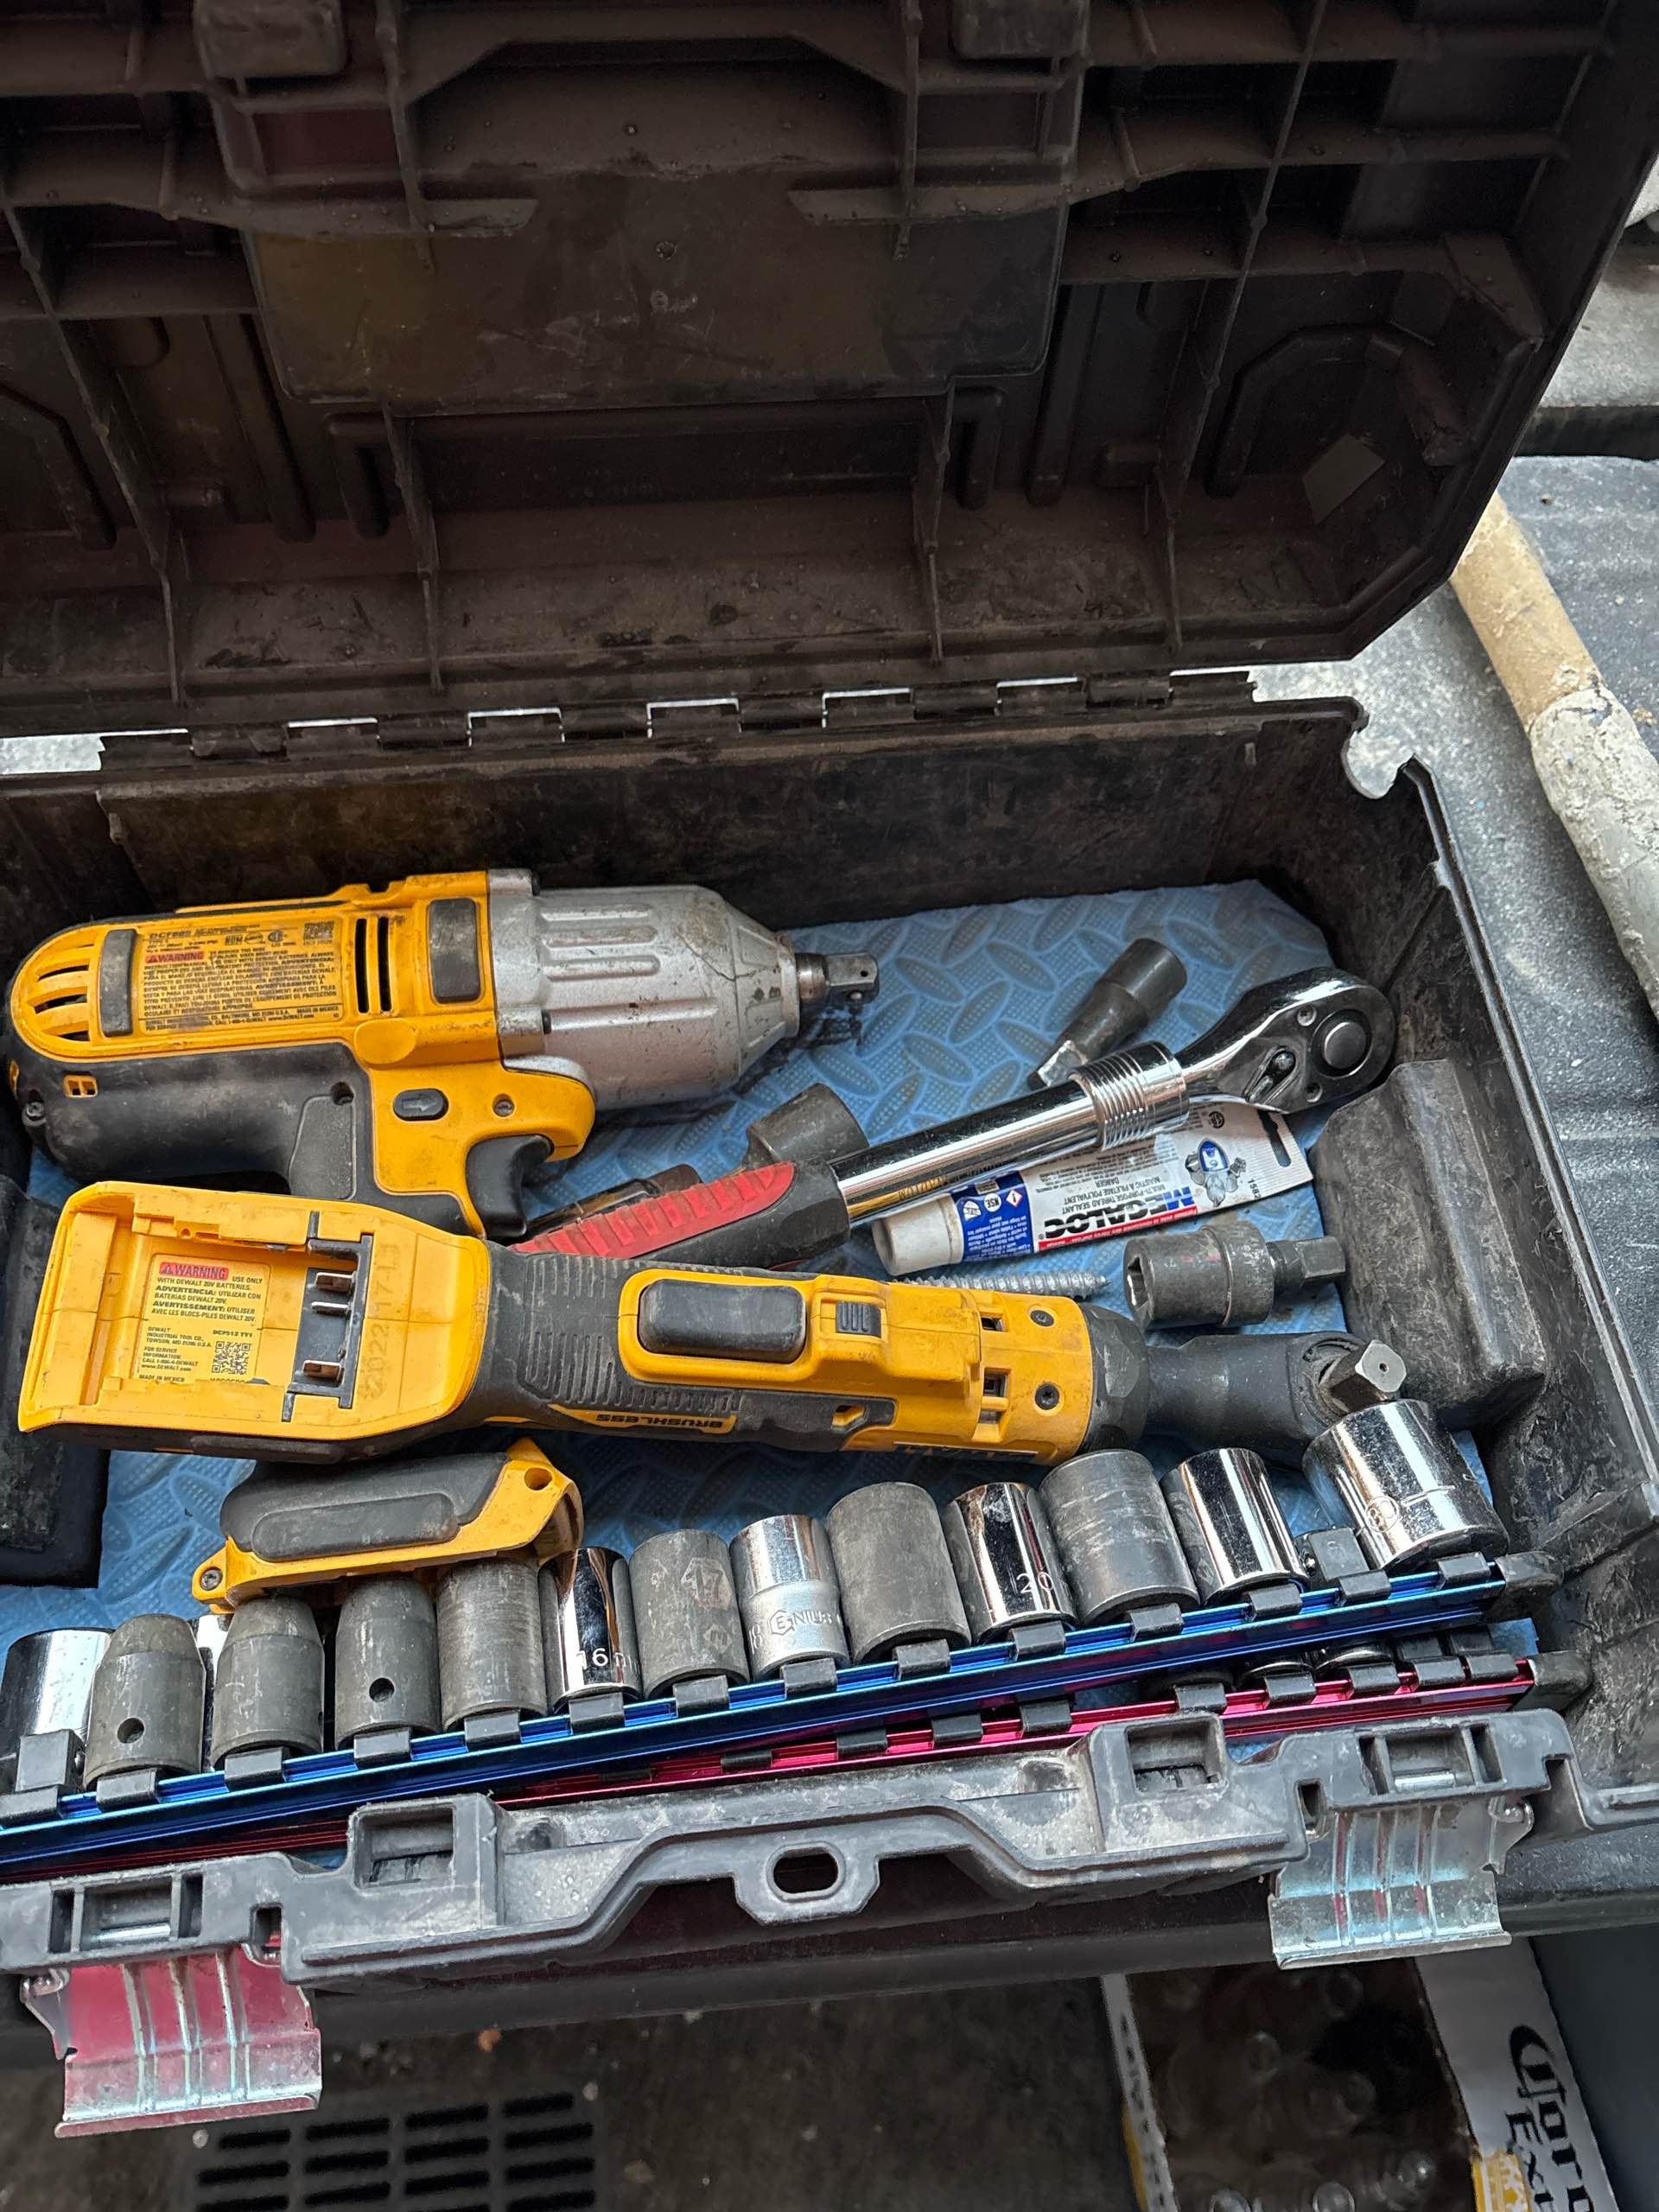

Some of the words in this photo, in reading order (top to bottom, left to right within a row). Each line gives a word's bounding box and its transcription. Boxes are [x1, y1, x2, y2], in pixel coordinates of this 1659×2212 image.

[157, 952, 203, 963] WARNING
[1064, 1189, 1103, 1205] POLYVALENT
[1090, 1194, 1116, 1207] THREAD
[1045, 1186, 1196, 1239] MEGALOC
[1062, 1199, 1091, 1215] SEALANT
[175, 1264, 226, 1279] WARNING
[156, 1285, 216, 1296] ADVERTENCIA:
[218, 1290, 247, 1299] UTILIZAR
[216, 1282, 251, 1291] BATTERIES.
[188, 1294, 214, 1303] DEWALT
[152, 1300, 226, 1312] AVERTISSEMENT:
[226, 1306, 256, 1315] UTILISER
[180, 1311, 218, 1319] BLOCS-PILES
[596, 1413, 724, 1428] BRUSHLESS
[684, 1562, 726, 1606] 17
[1015, 1572, 1055, 1595] 20
[747, 1624, 762, 1656] 18
[576, 1647, 608, 1670] 16
